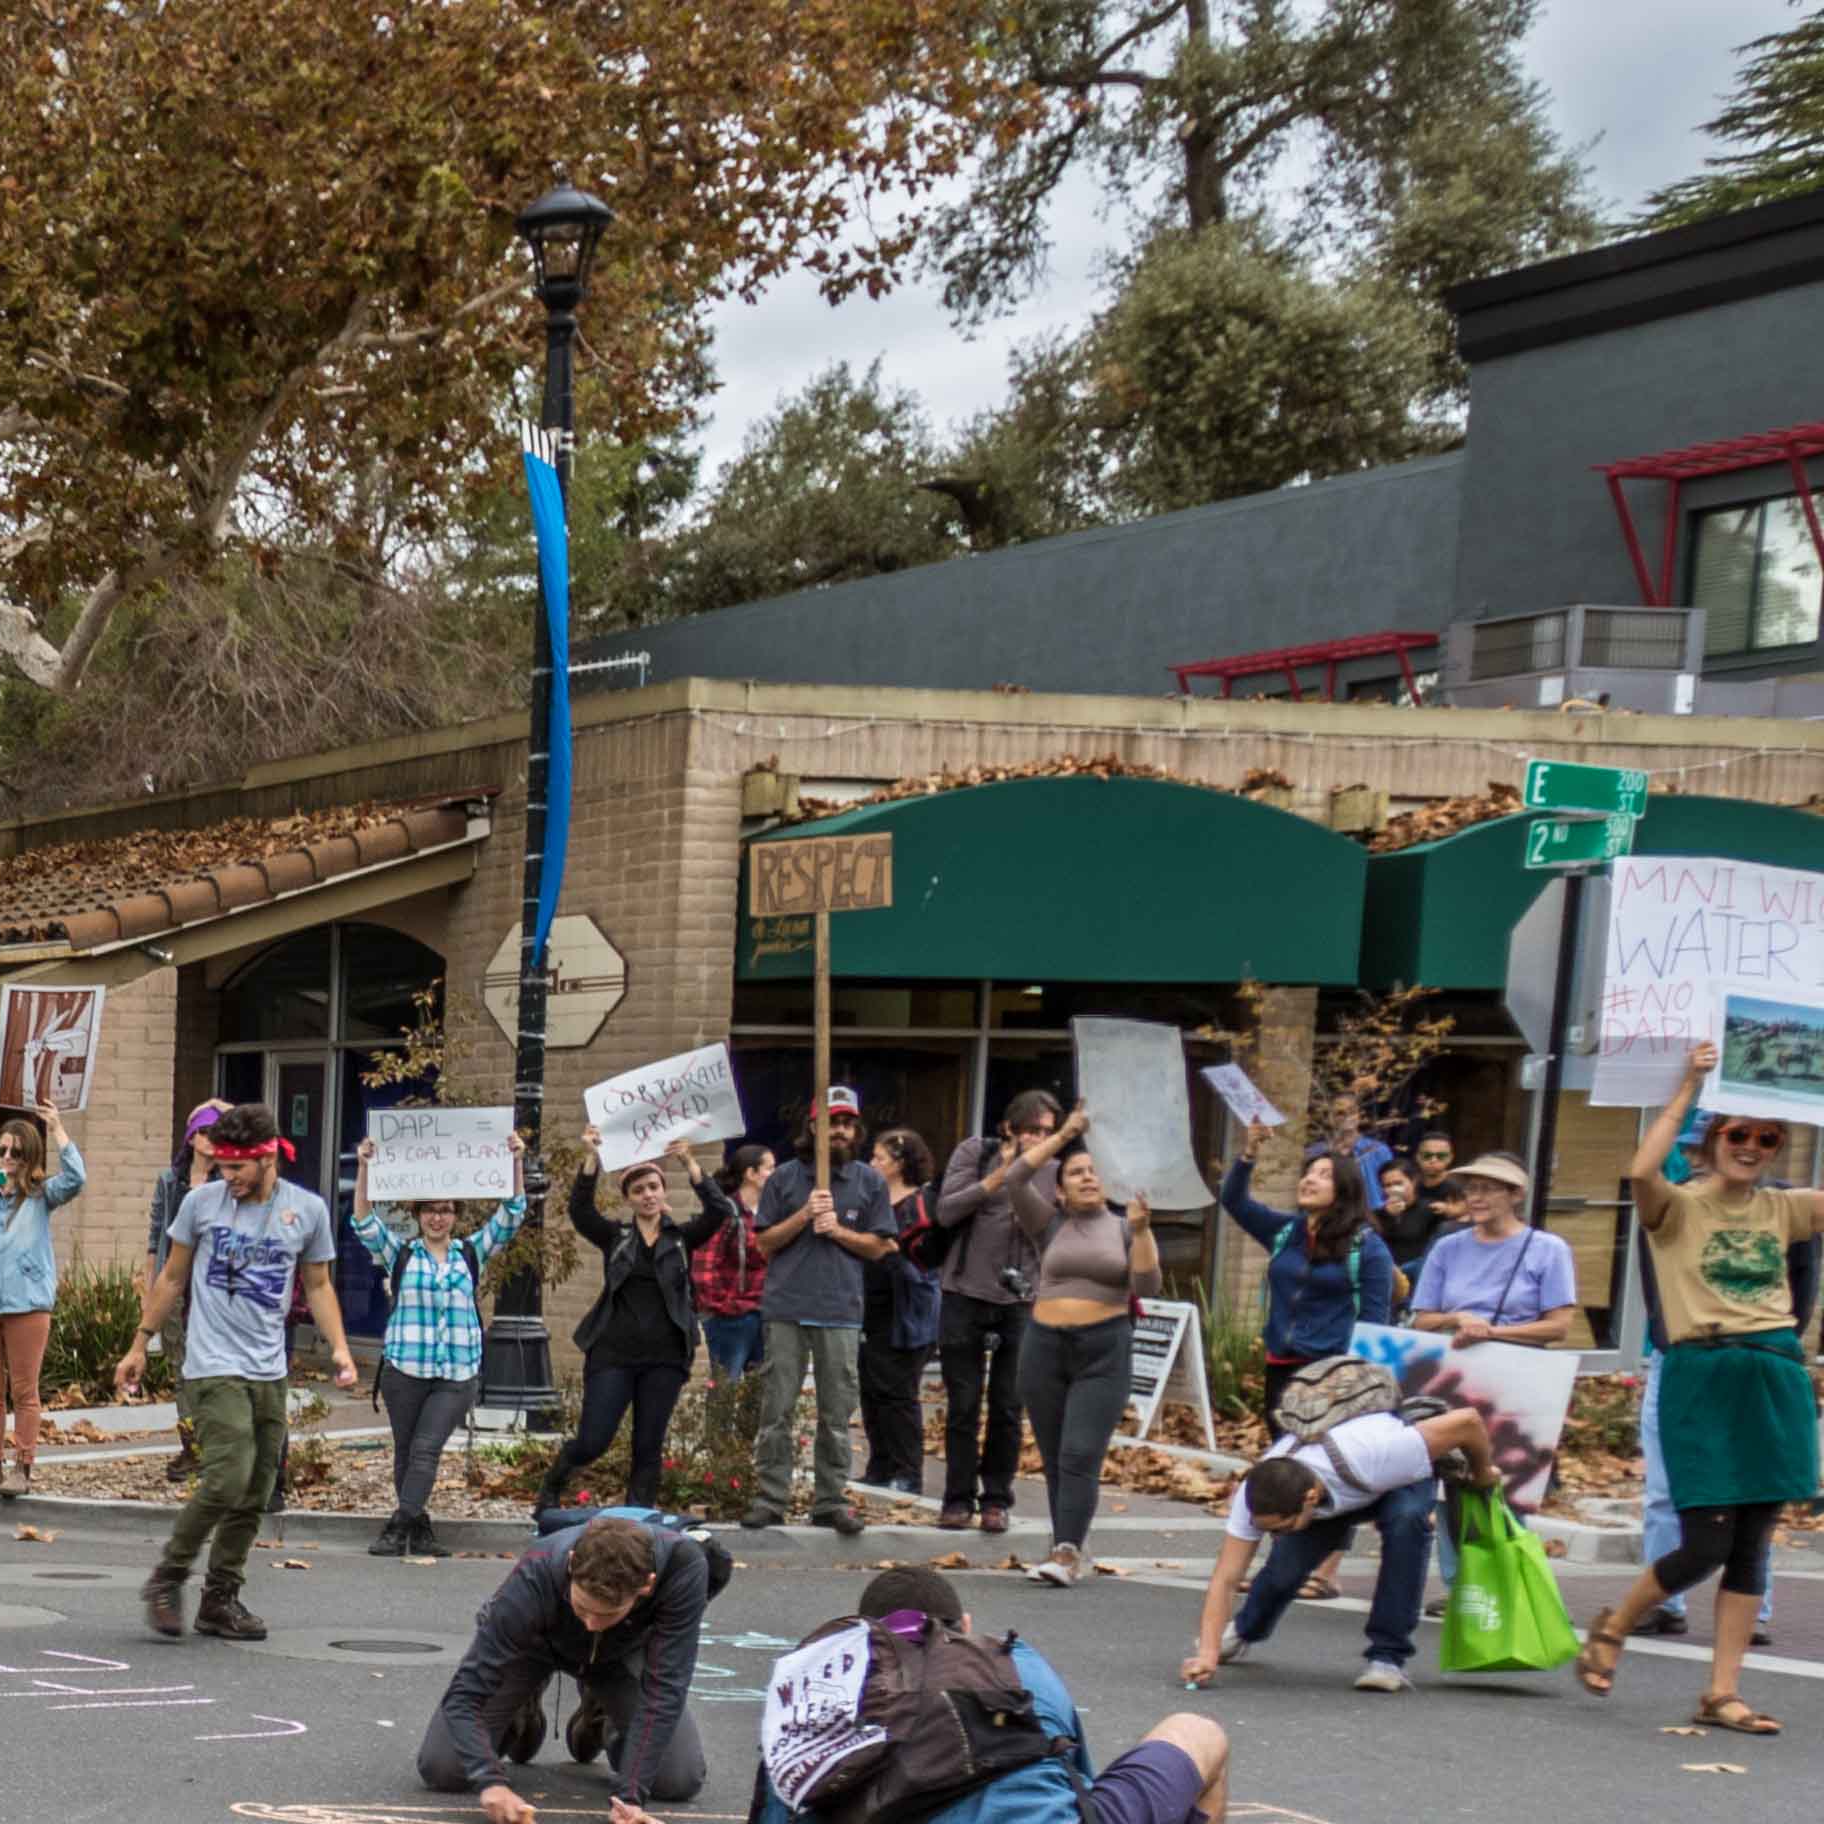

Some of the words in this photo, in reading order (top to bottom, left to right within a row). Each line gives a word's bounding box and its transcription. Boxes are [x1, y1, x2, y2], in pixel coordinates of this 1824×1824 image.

[1532, 765, 1551, 803] E
[757, 840, 893, 912] RESPECT
[1618, 863, 1737, 911] MNI
[1759, 875, 1824, 925] WI
[1615, 908, 1801, 982] WATER
[1601, 981, 1694, 1015] #NO
[603, 1061, 727, 1114] CORPORATE
[379, 1114, 452, 1142] DAPL
[632, 1093, 710, 1143] GREED
[406, 1145, 448, 1161] COAL
[375, 1170, 434, 1189] WORTH
[441, 1170, 460, 1187] OF
